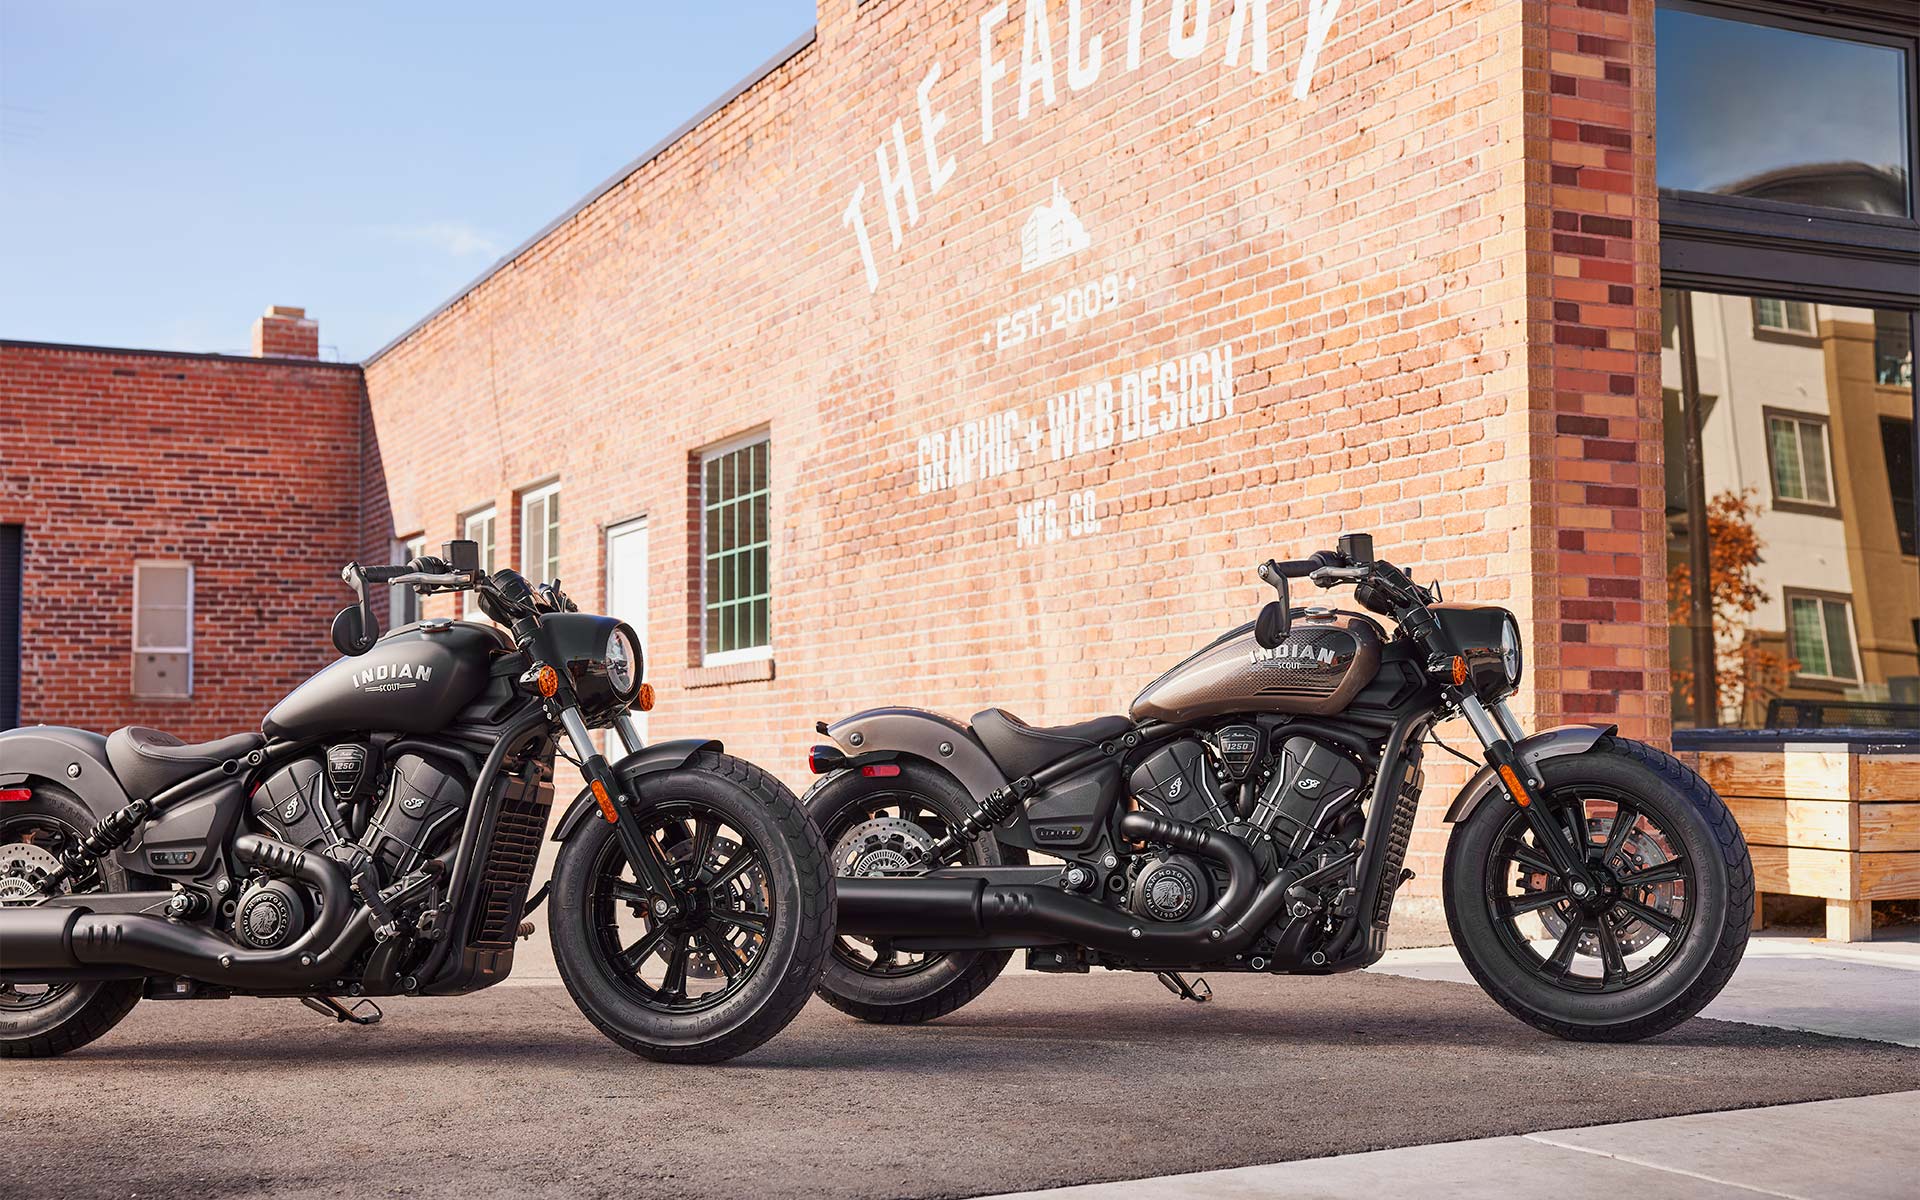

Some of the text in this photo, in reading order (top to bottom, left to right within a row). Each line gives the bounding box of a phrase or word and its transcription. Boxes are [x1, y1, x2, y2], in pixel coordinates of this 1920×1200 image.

[842, 62, 957, 294] THE
[997, 273, 1119, 351] EST. 2009
[917, 409, 1020, 495] GRAPHIC
[1046, 380, 1114, 461] WEB
[1121, 345, 1235, 441] DESIGN
[1016, 490, 1102, 549] MFG. CO.
[1248, 644, 1336, 665] INDIAN
[1277, 661, 1301, 669] SCOUT
[352, 663, 433, 689] INDIAN
[379, 682, 401, 692] SCOUT
[1227, 743, 1249, 751] 1250
[334, 762, 355, 770] 1250
[255, 895, 288, 936] MOTORCYCLE
